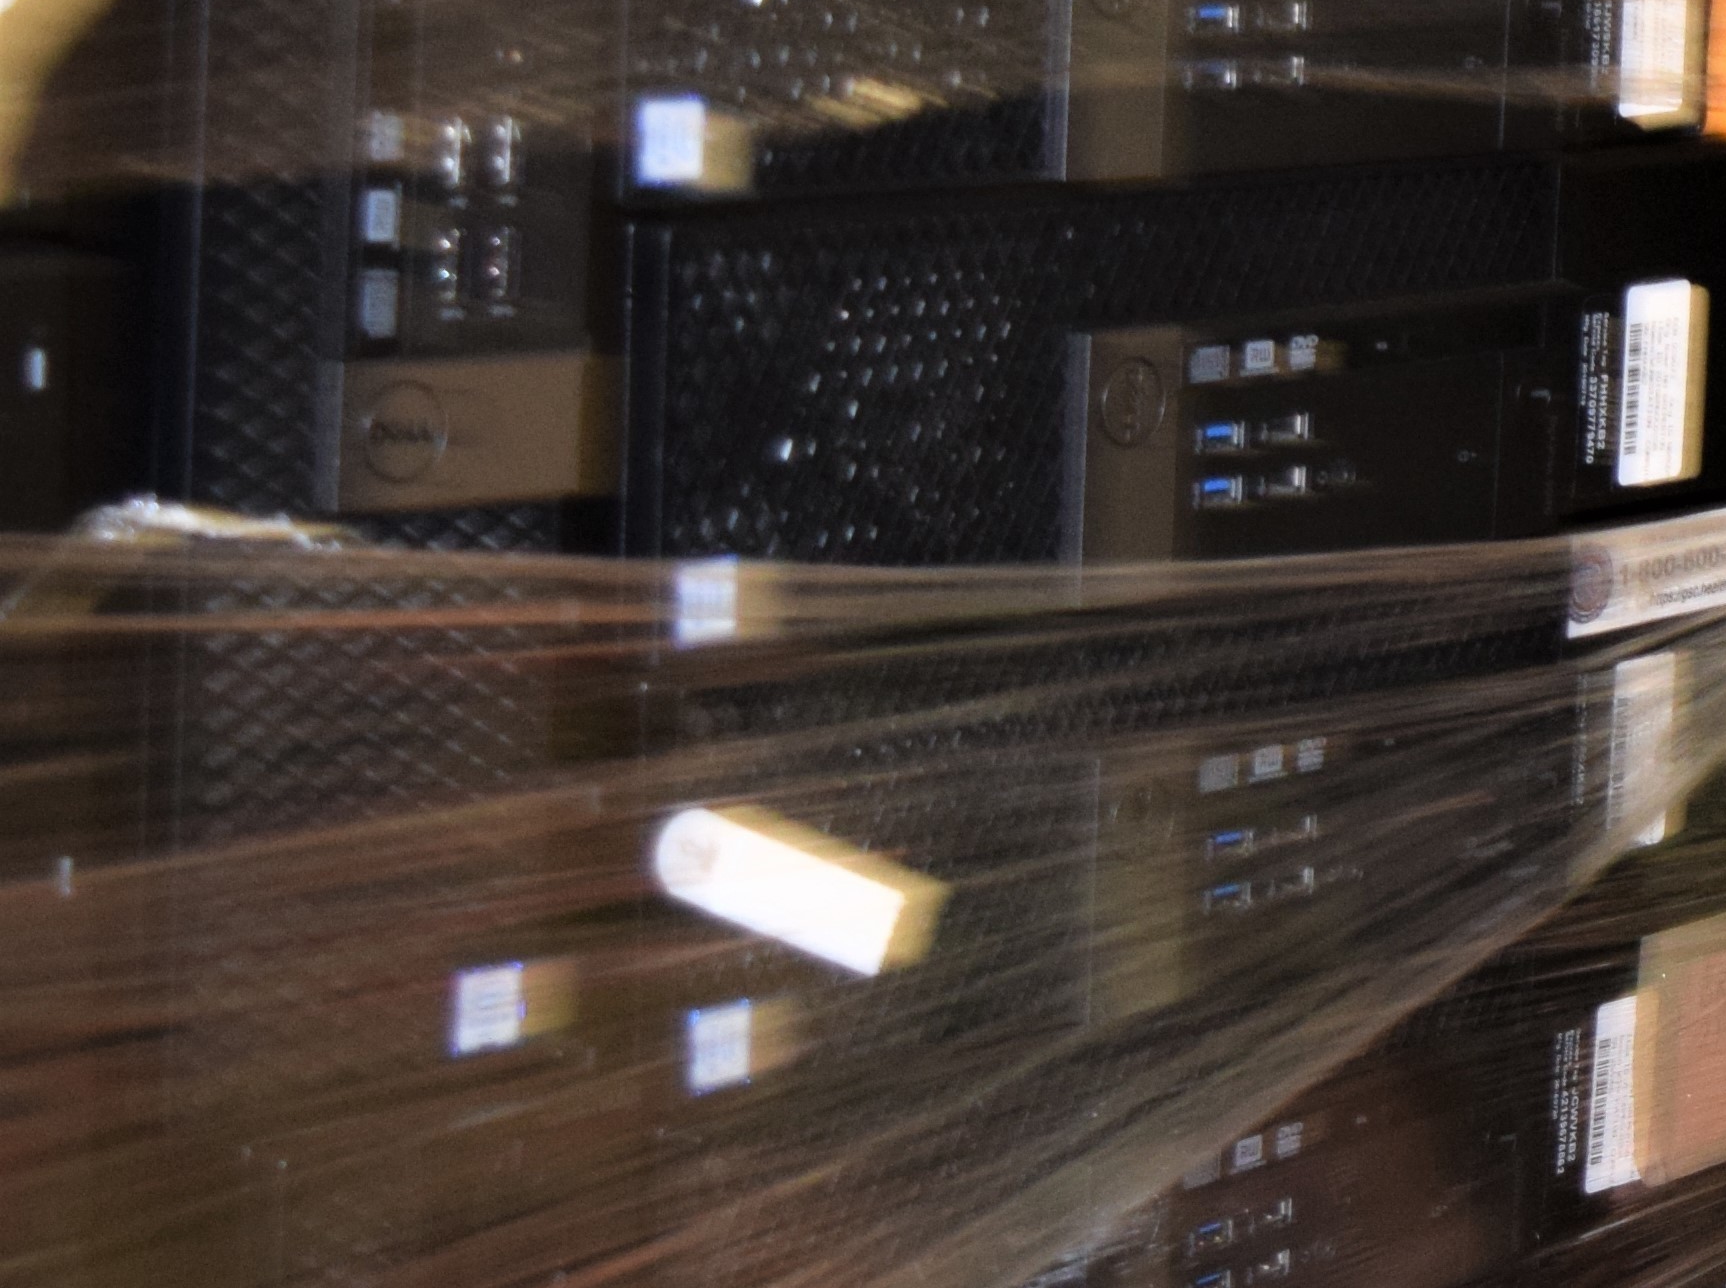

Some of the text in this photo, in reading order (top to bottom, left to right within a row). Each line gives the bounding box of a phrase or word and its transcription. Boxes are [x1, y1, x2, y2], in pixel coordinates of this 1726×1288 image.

[1585, 376, 1597, 464] 33709779470
[1597, 375, 1609, 450] FHHXKB2
[1278, 1122, 1304, 1136] DVD
[1567, 1087, 1579, 1161] JCWVKB2
